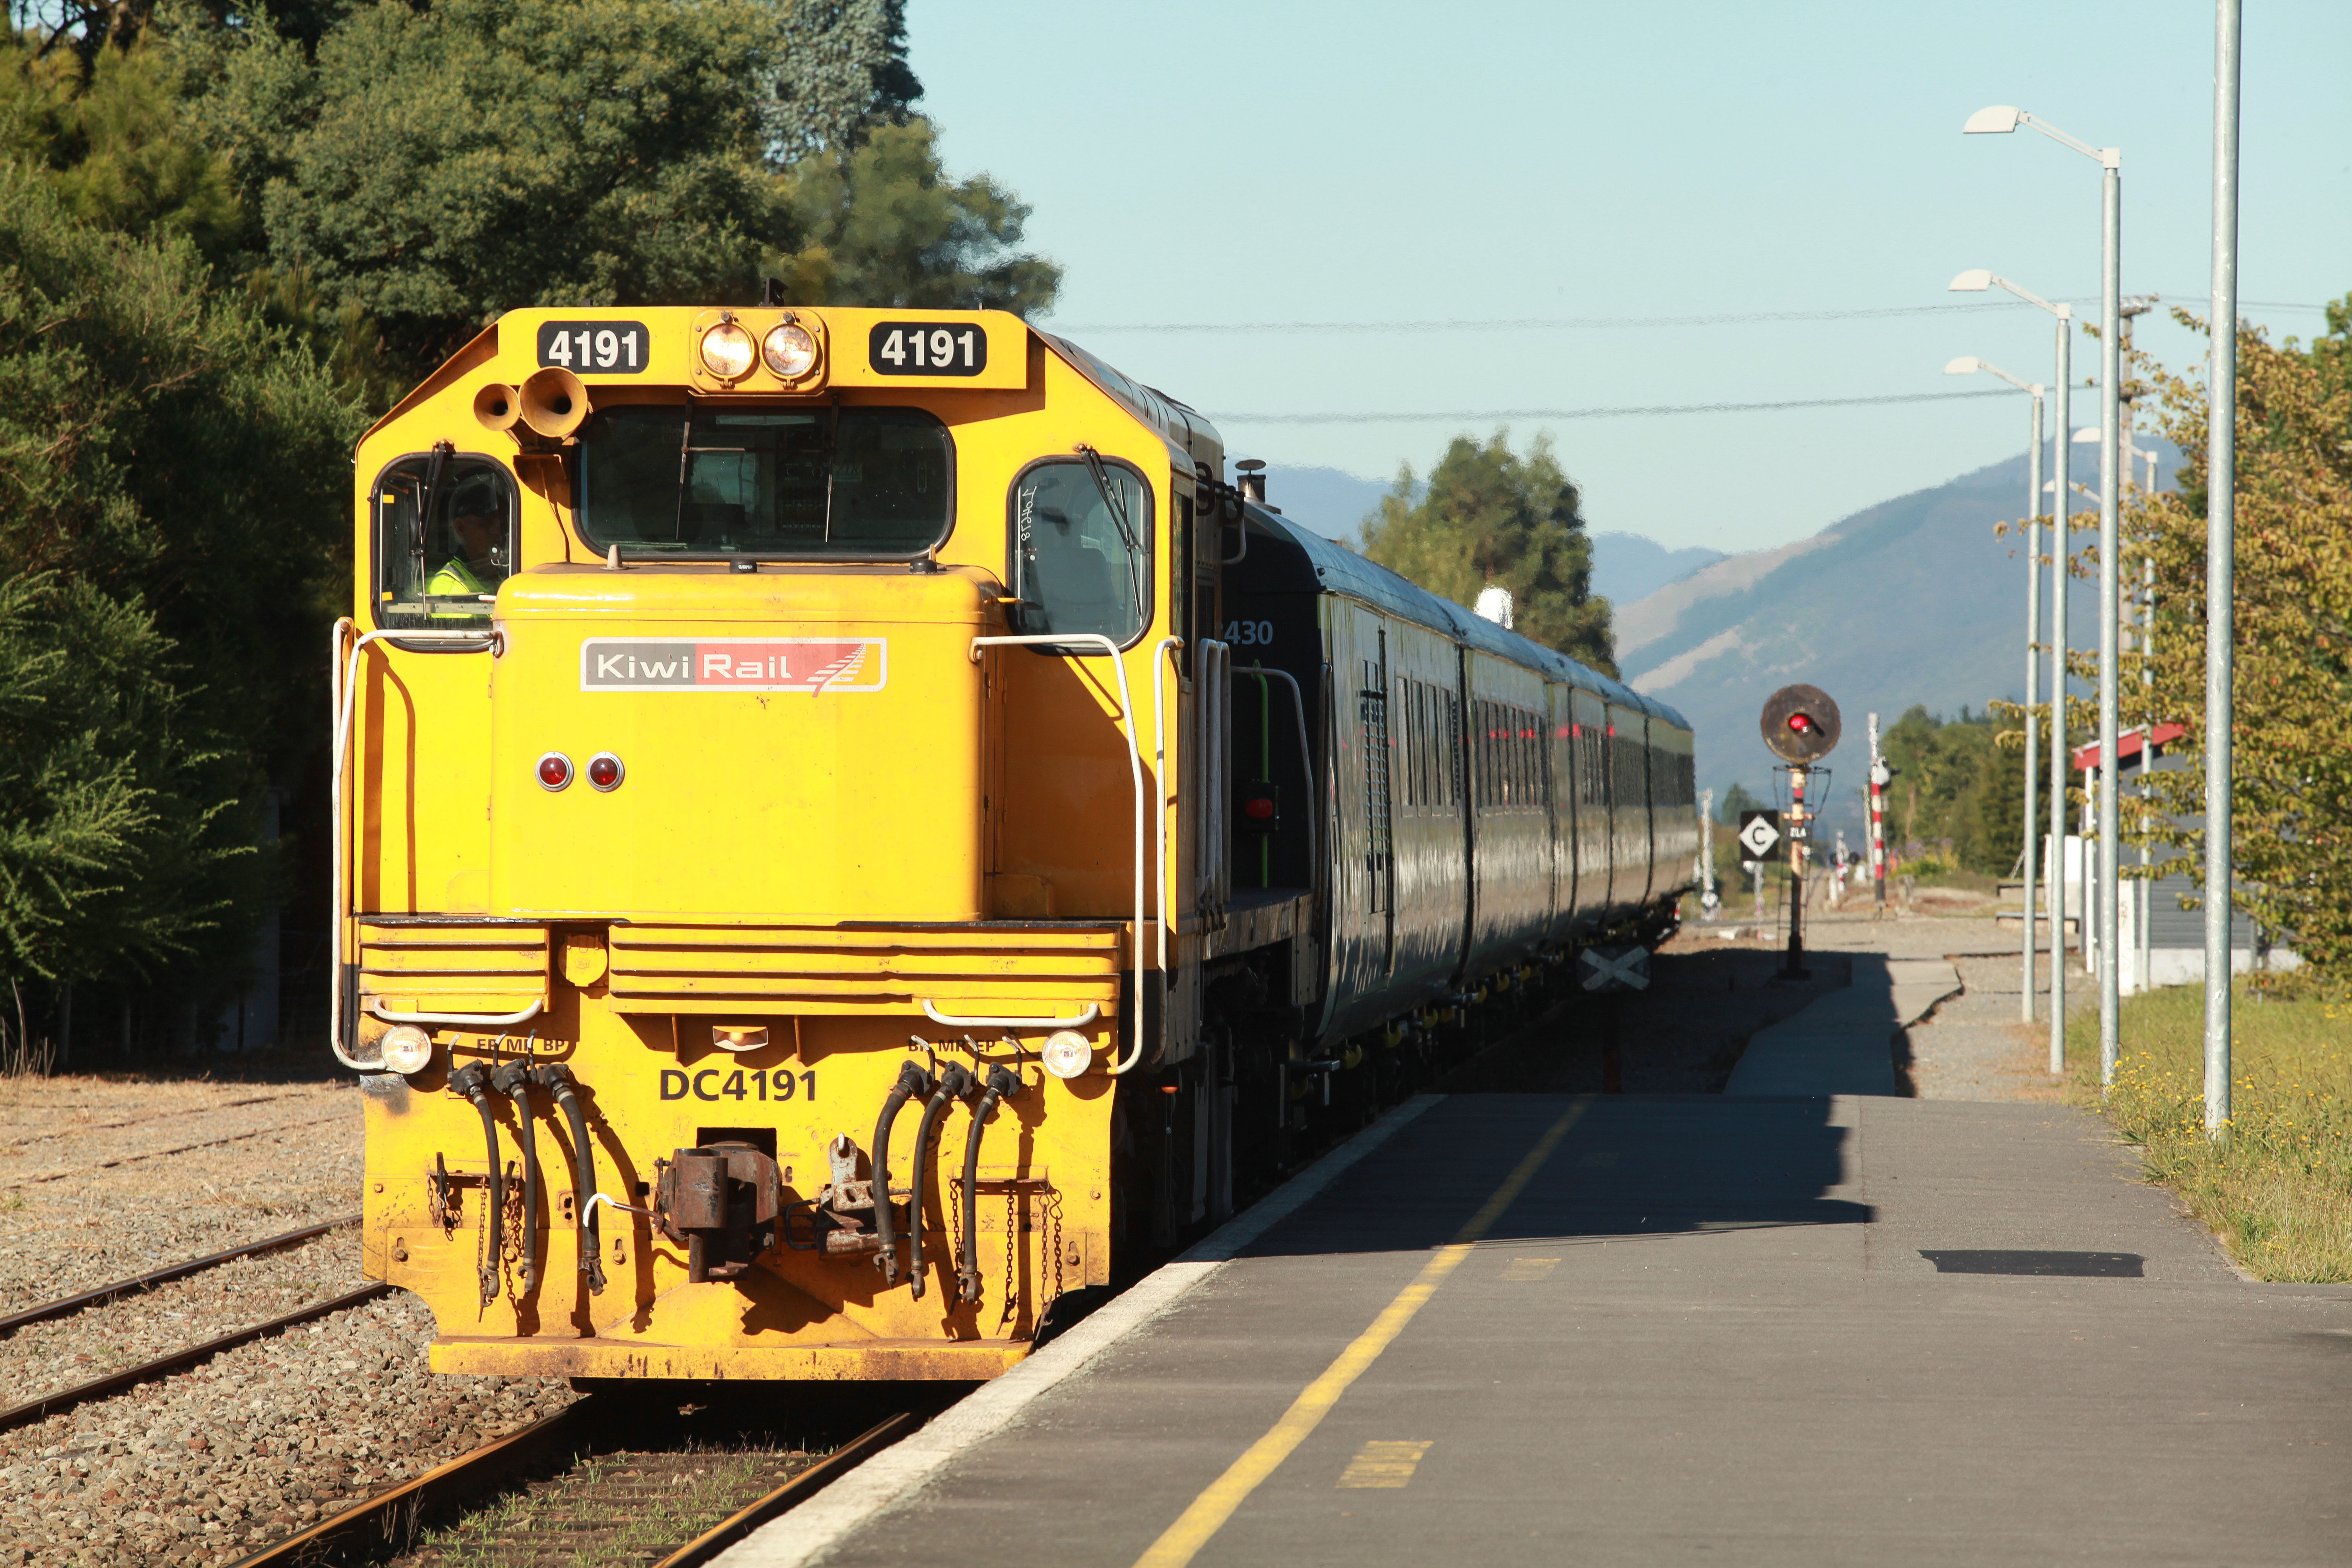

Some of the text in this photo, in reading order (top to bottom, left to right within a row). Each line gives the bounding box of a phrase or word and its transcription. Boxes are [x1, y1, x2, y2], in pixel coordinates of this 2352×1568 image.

[548, 330, 637, 368] 4191
[881, 330, 974, 367] 4191
[598, 654, 793, 678] Kiwi Rail
[1752, 827, 1766, 844] C
[544, 1039, 565, 1051] BP
[939, 1039, 966, 1052] MR
[660, 1069, 815, 1101] DC4191
